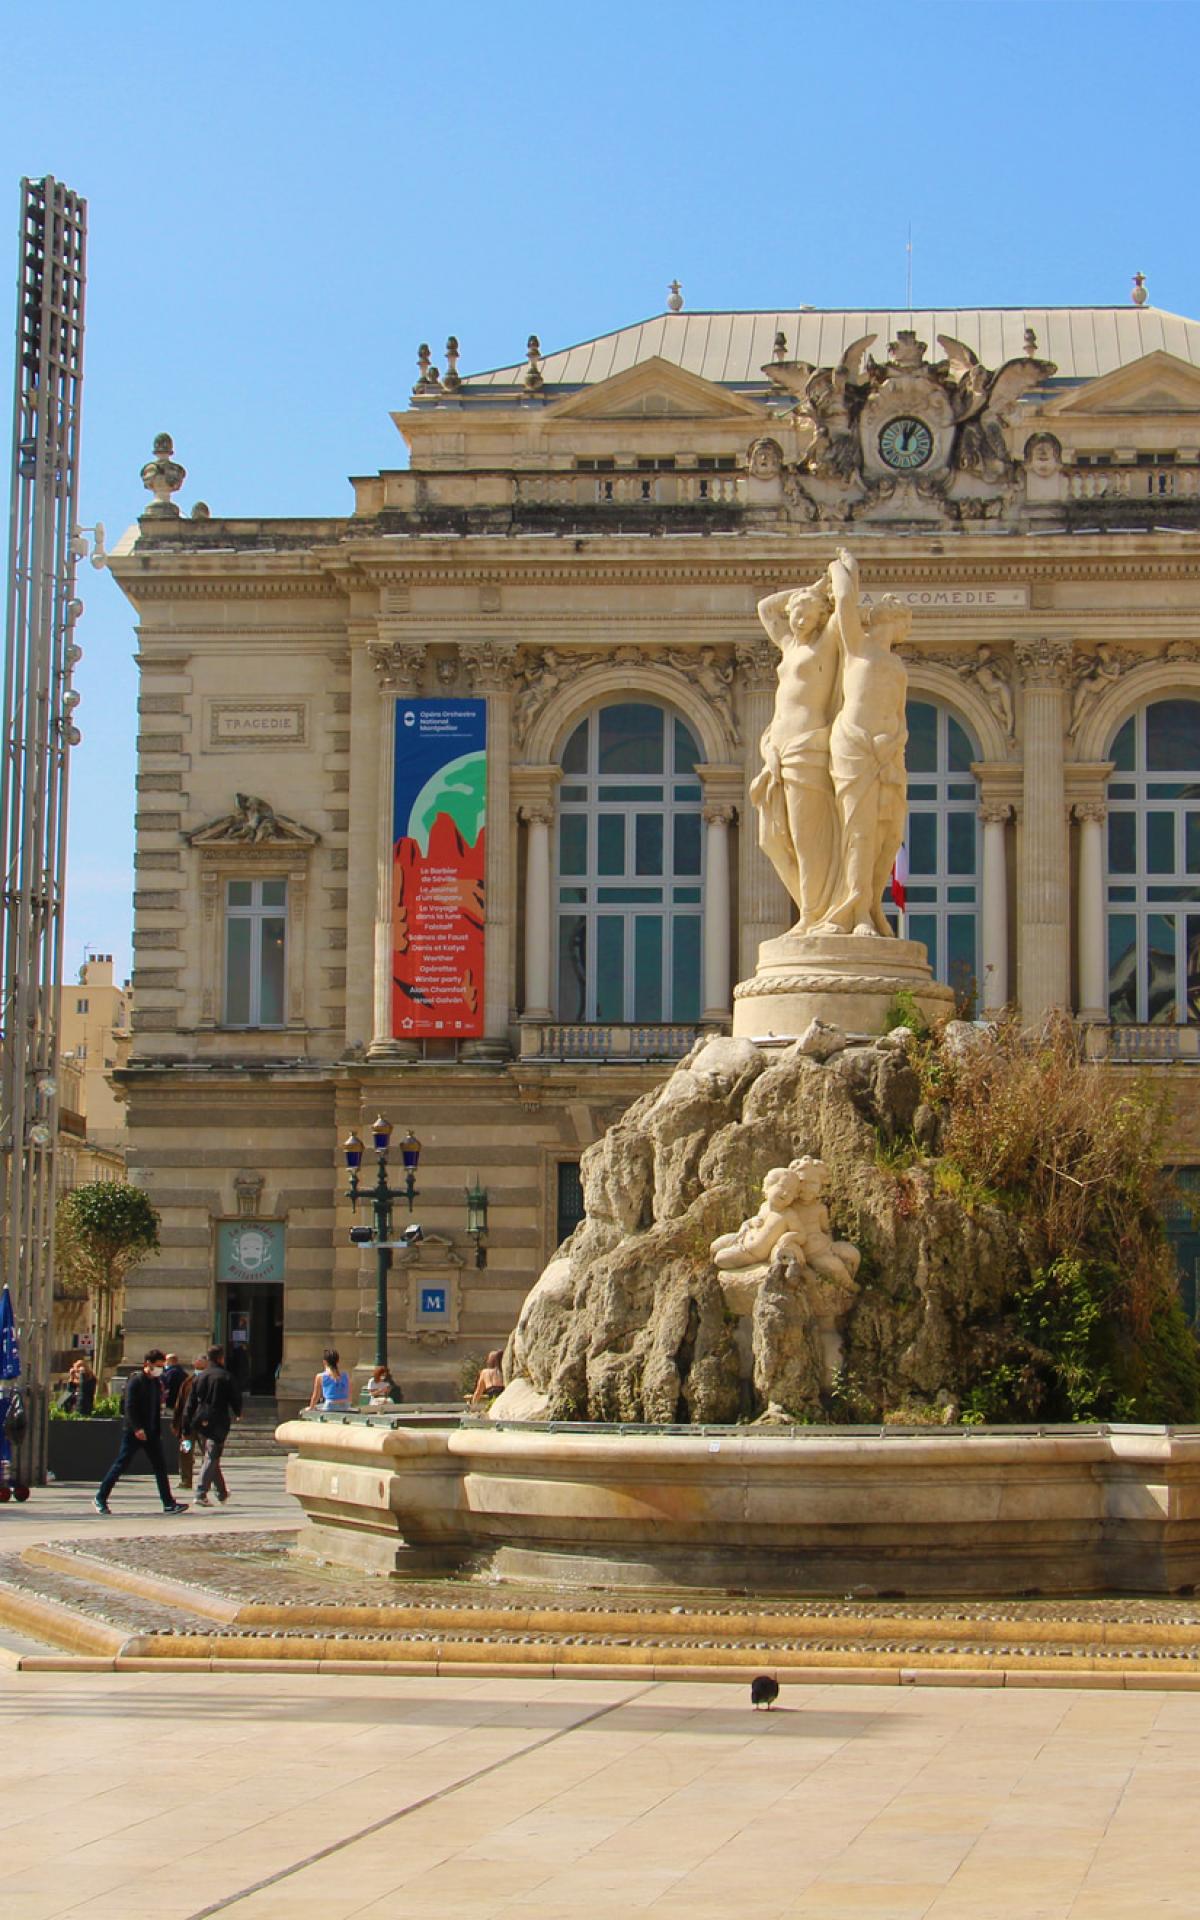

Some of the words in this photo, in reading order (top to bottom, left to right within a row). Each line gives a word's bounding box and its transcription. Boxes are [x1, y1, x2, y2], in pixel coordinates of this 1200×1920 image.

[862, 594, 873, 604] A
[907, 592, 997, 604] COMEDIE
[224, 719, 292, 729] TRAGEDIE
[425, 1295, 441, 1309] M
